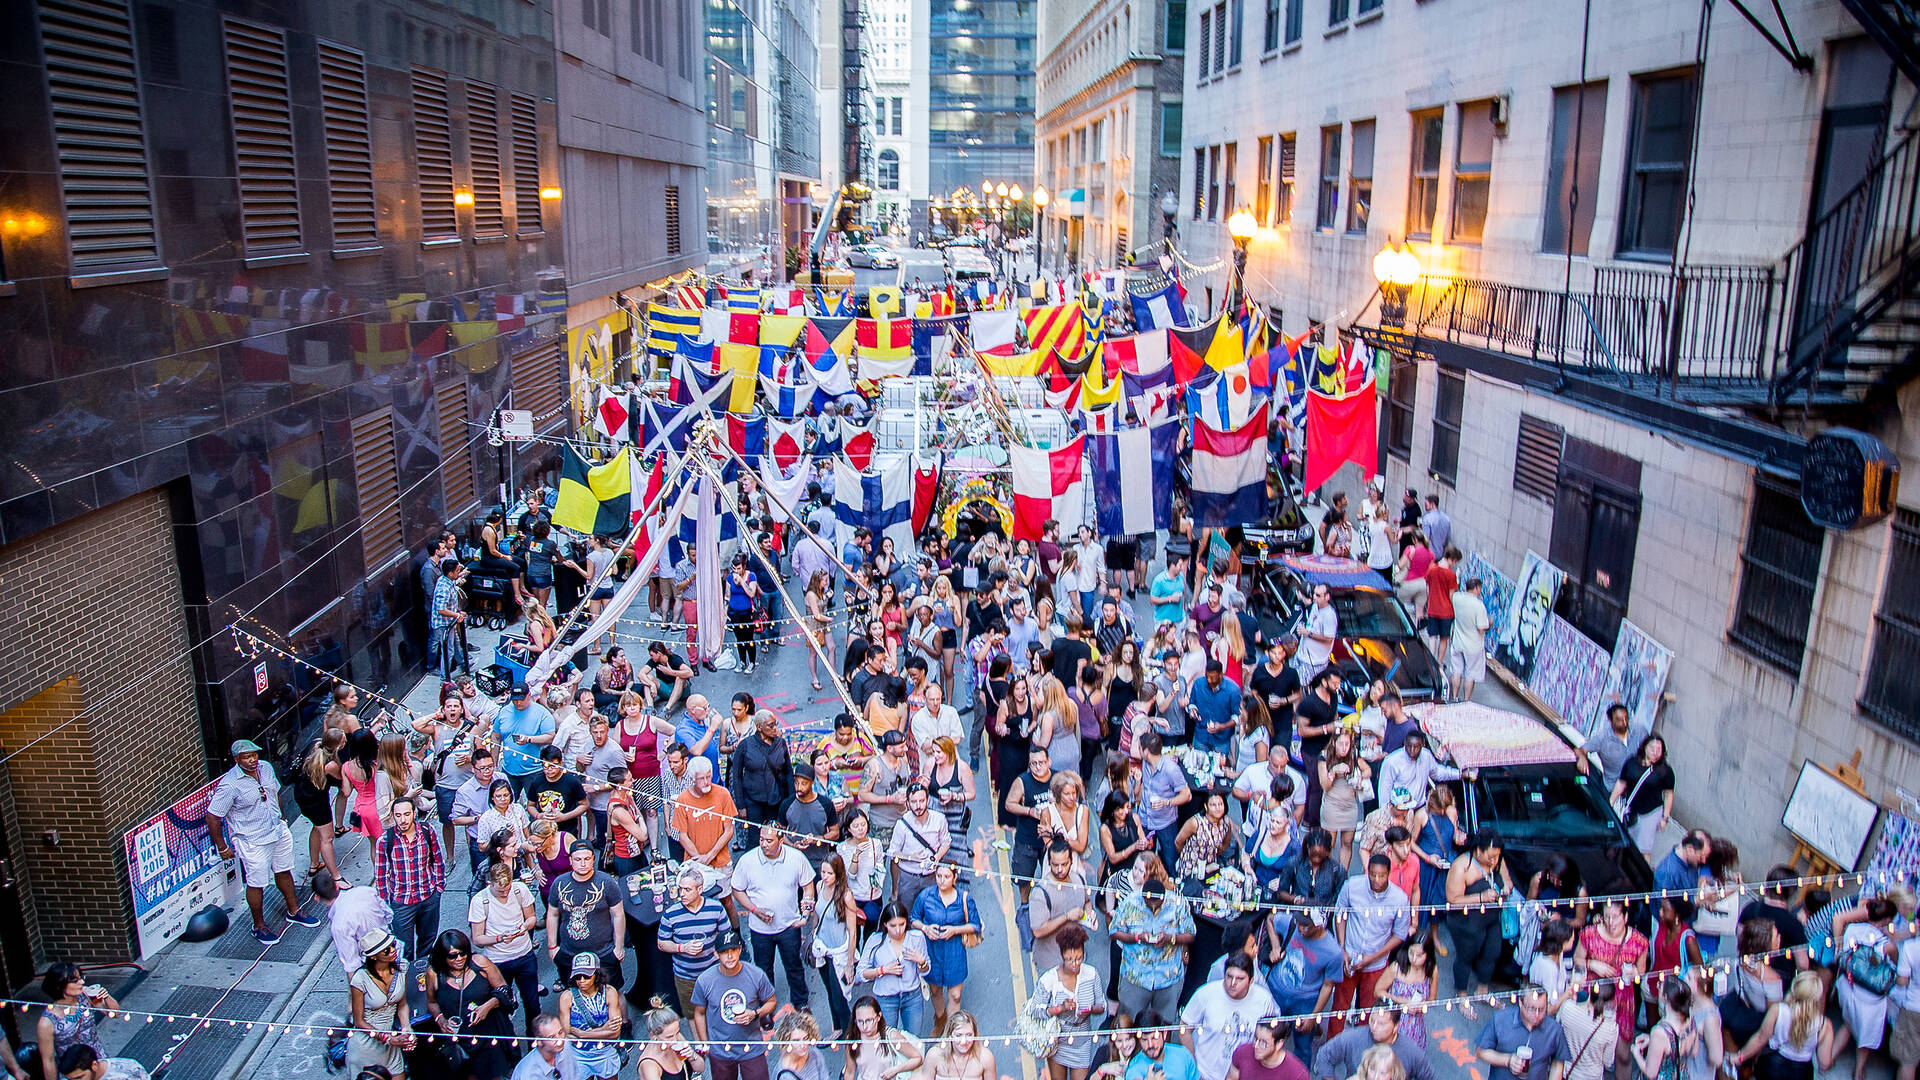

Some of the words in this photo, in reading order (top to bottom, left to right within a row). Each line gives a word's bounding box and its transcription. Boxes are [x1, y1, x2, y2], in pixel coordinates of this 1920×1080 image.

[139, 826, 161, 849] ACTI
[140, 841, 163, 863] VATE
[143, 855, 165, 878] 2016
